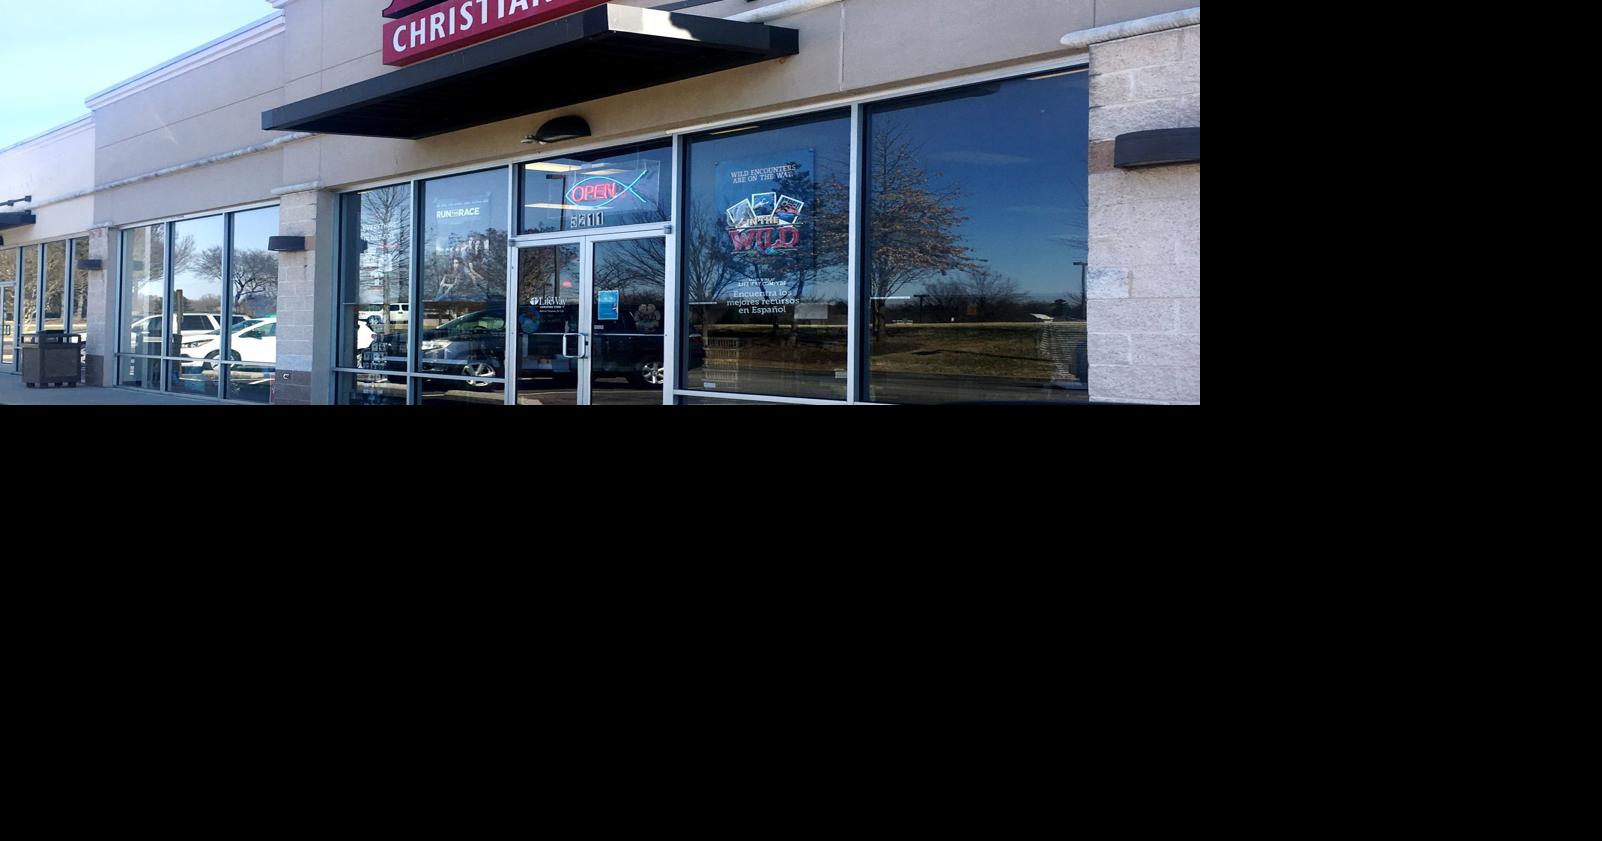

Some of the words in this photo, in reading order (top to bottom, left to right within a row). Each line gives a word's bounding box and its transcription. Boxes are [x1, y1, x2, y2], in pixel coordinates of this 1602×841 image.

[392, 0, 552, 53] CHRISTIA
[730, 170, 749, 178] WILD
[750, 164, 797, 176] ENCOUNTERS
[732, 176, 747, 185] ARE
[747, 174, 757, 182] ON
[759, 173, 775, 181] THE
[571, 182, 617, 202] OPEN
[747, 217, 758, 226] IN
[757, 216, 780, 225] THE
[728, 226, 800, 252] WILD
[733, 290, 777, 298] Encuentra
[779, 289, 792, 297] los
[539, 295, 567, 307] LifeWay
[726, 299, 760, 307] mejores
[751, 305, 787, 315] Español
